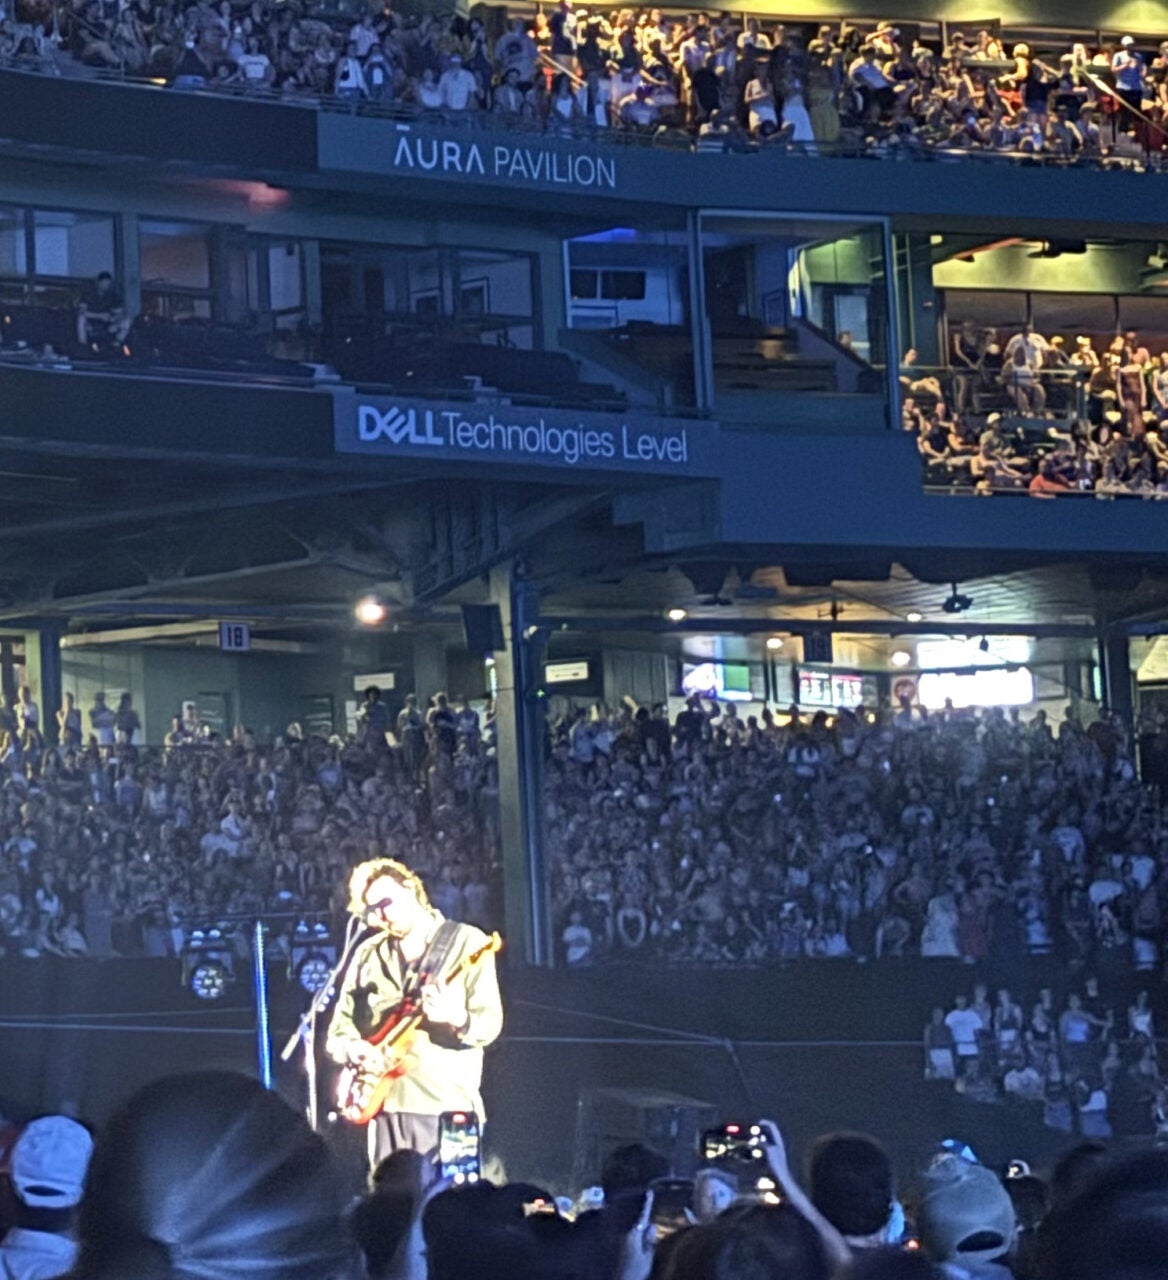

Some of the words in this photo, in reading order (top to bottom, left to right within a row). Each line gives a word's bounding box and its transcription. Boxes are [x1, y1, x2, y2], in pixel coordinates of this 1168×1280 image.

[494, 146, 616, 188] PAVILION
[358, 405, 444, 445] DELL
[440, 411, 615, 464] Technologies
[622, 424, 688, 462] Level
[227, 626, 243, 648] 18
